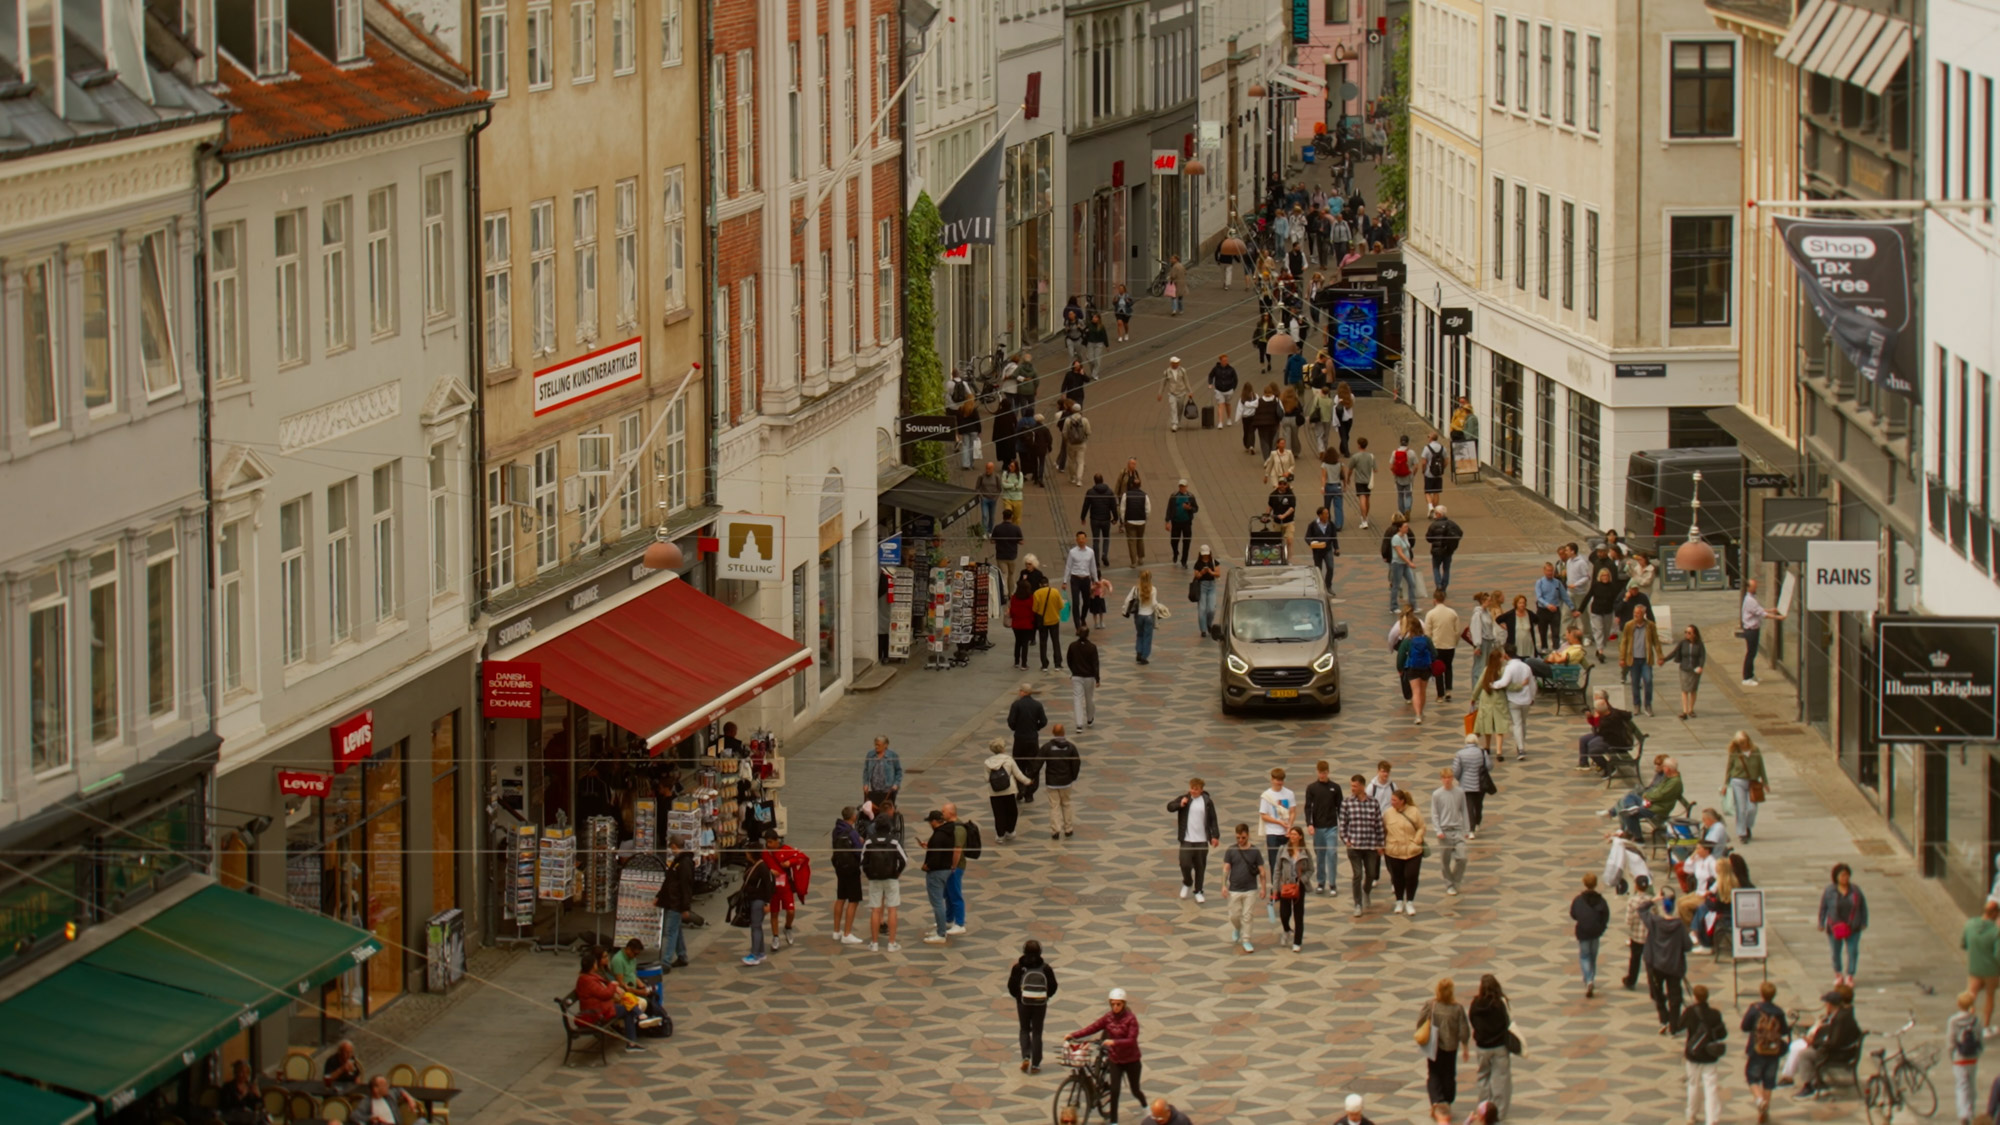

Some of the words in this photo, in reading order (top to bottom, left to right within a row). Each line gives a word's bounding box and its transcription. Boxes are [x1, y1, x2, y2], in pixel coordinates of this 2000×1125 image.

[1809, 239, 1867, 258] Shop
[1811, 258, 1852, 275] Tax
[1818, 276, 1870, 293] Free
[539, 374, 571, 400] STELLING
[572, 351, 638, 388] KUNSTNERARTIKLER
[905, 423, 951, 433] Souvenirs
[1767, 522, 1825, 537] ALIS
[727, 563, 773, 574] STELLING
[1817, 568, 1872, 585] RAINS
[489, 680, 533, 689] SOUVENIRS
[496, 672, 526, 681] DANISH
[1885, 680, 1930, 695] Illums
[1931, 680, 1992, 699] Bolighus
[490, 699, 532, 708] EXCHANGE
